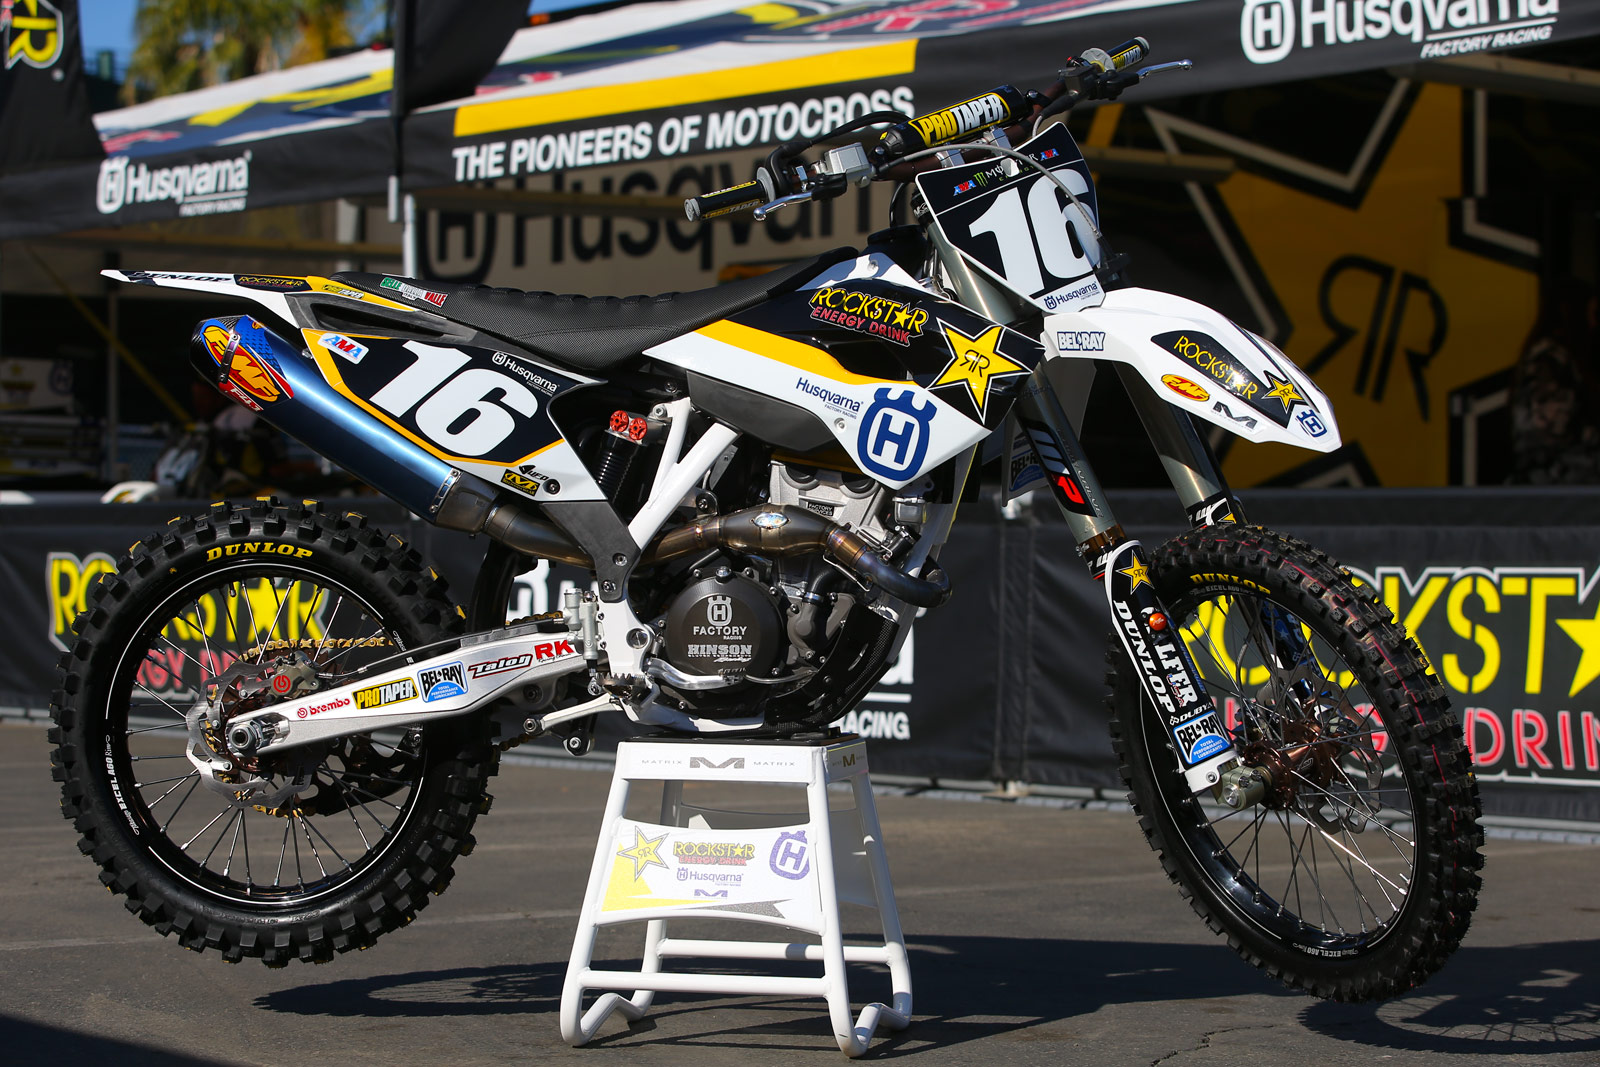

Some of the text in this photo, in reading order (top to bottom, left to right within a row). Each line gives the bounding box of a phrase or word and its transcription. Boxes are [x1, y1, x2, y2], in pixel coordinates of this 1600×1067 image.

[1420, 25, 1553, 59] FACTORY RACING
[453, 86, 916, 182] THE PIONEERS OF MOTOCROSS
[918, 94, 1005, 147] PROTAPER
[126, 157, 249, 205] Husqvarna
[969, 168, 1101, 295] 16
[1055, 282, 1098, 305] Husqvarna
[812, 306, 911, 346] ENERGY DRINK
[324, 335, 363, 358] AMA
[504, 358, 558, 393] Husqvarna
[369, 340, 538, 456] 16
[795, 377, 861, 412] Husqvarna
[206, 542, 313, 562] DUNLOP
[1189, 573, 1271, 595] DUNLOP
[693, 625, 748, 636] FACTORY
[534, 639, 575, 660] RK
[687, 644, 753, 655] HINSON
[1113, 600, 1177, 714] DUNLOP
[309, 697, 351, 716] brembo
[355, 681, 417, 709] PROTAPER
[679, 856, 747, 866] ENERGY DRINK
[689, 871, 742, 882] Husqvarna
